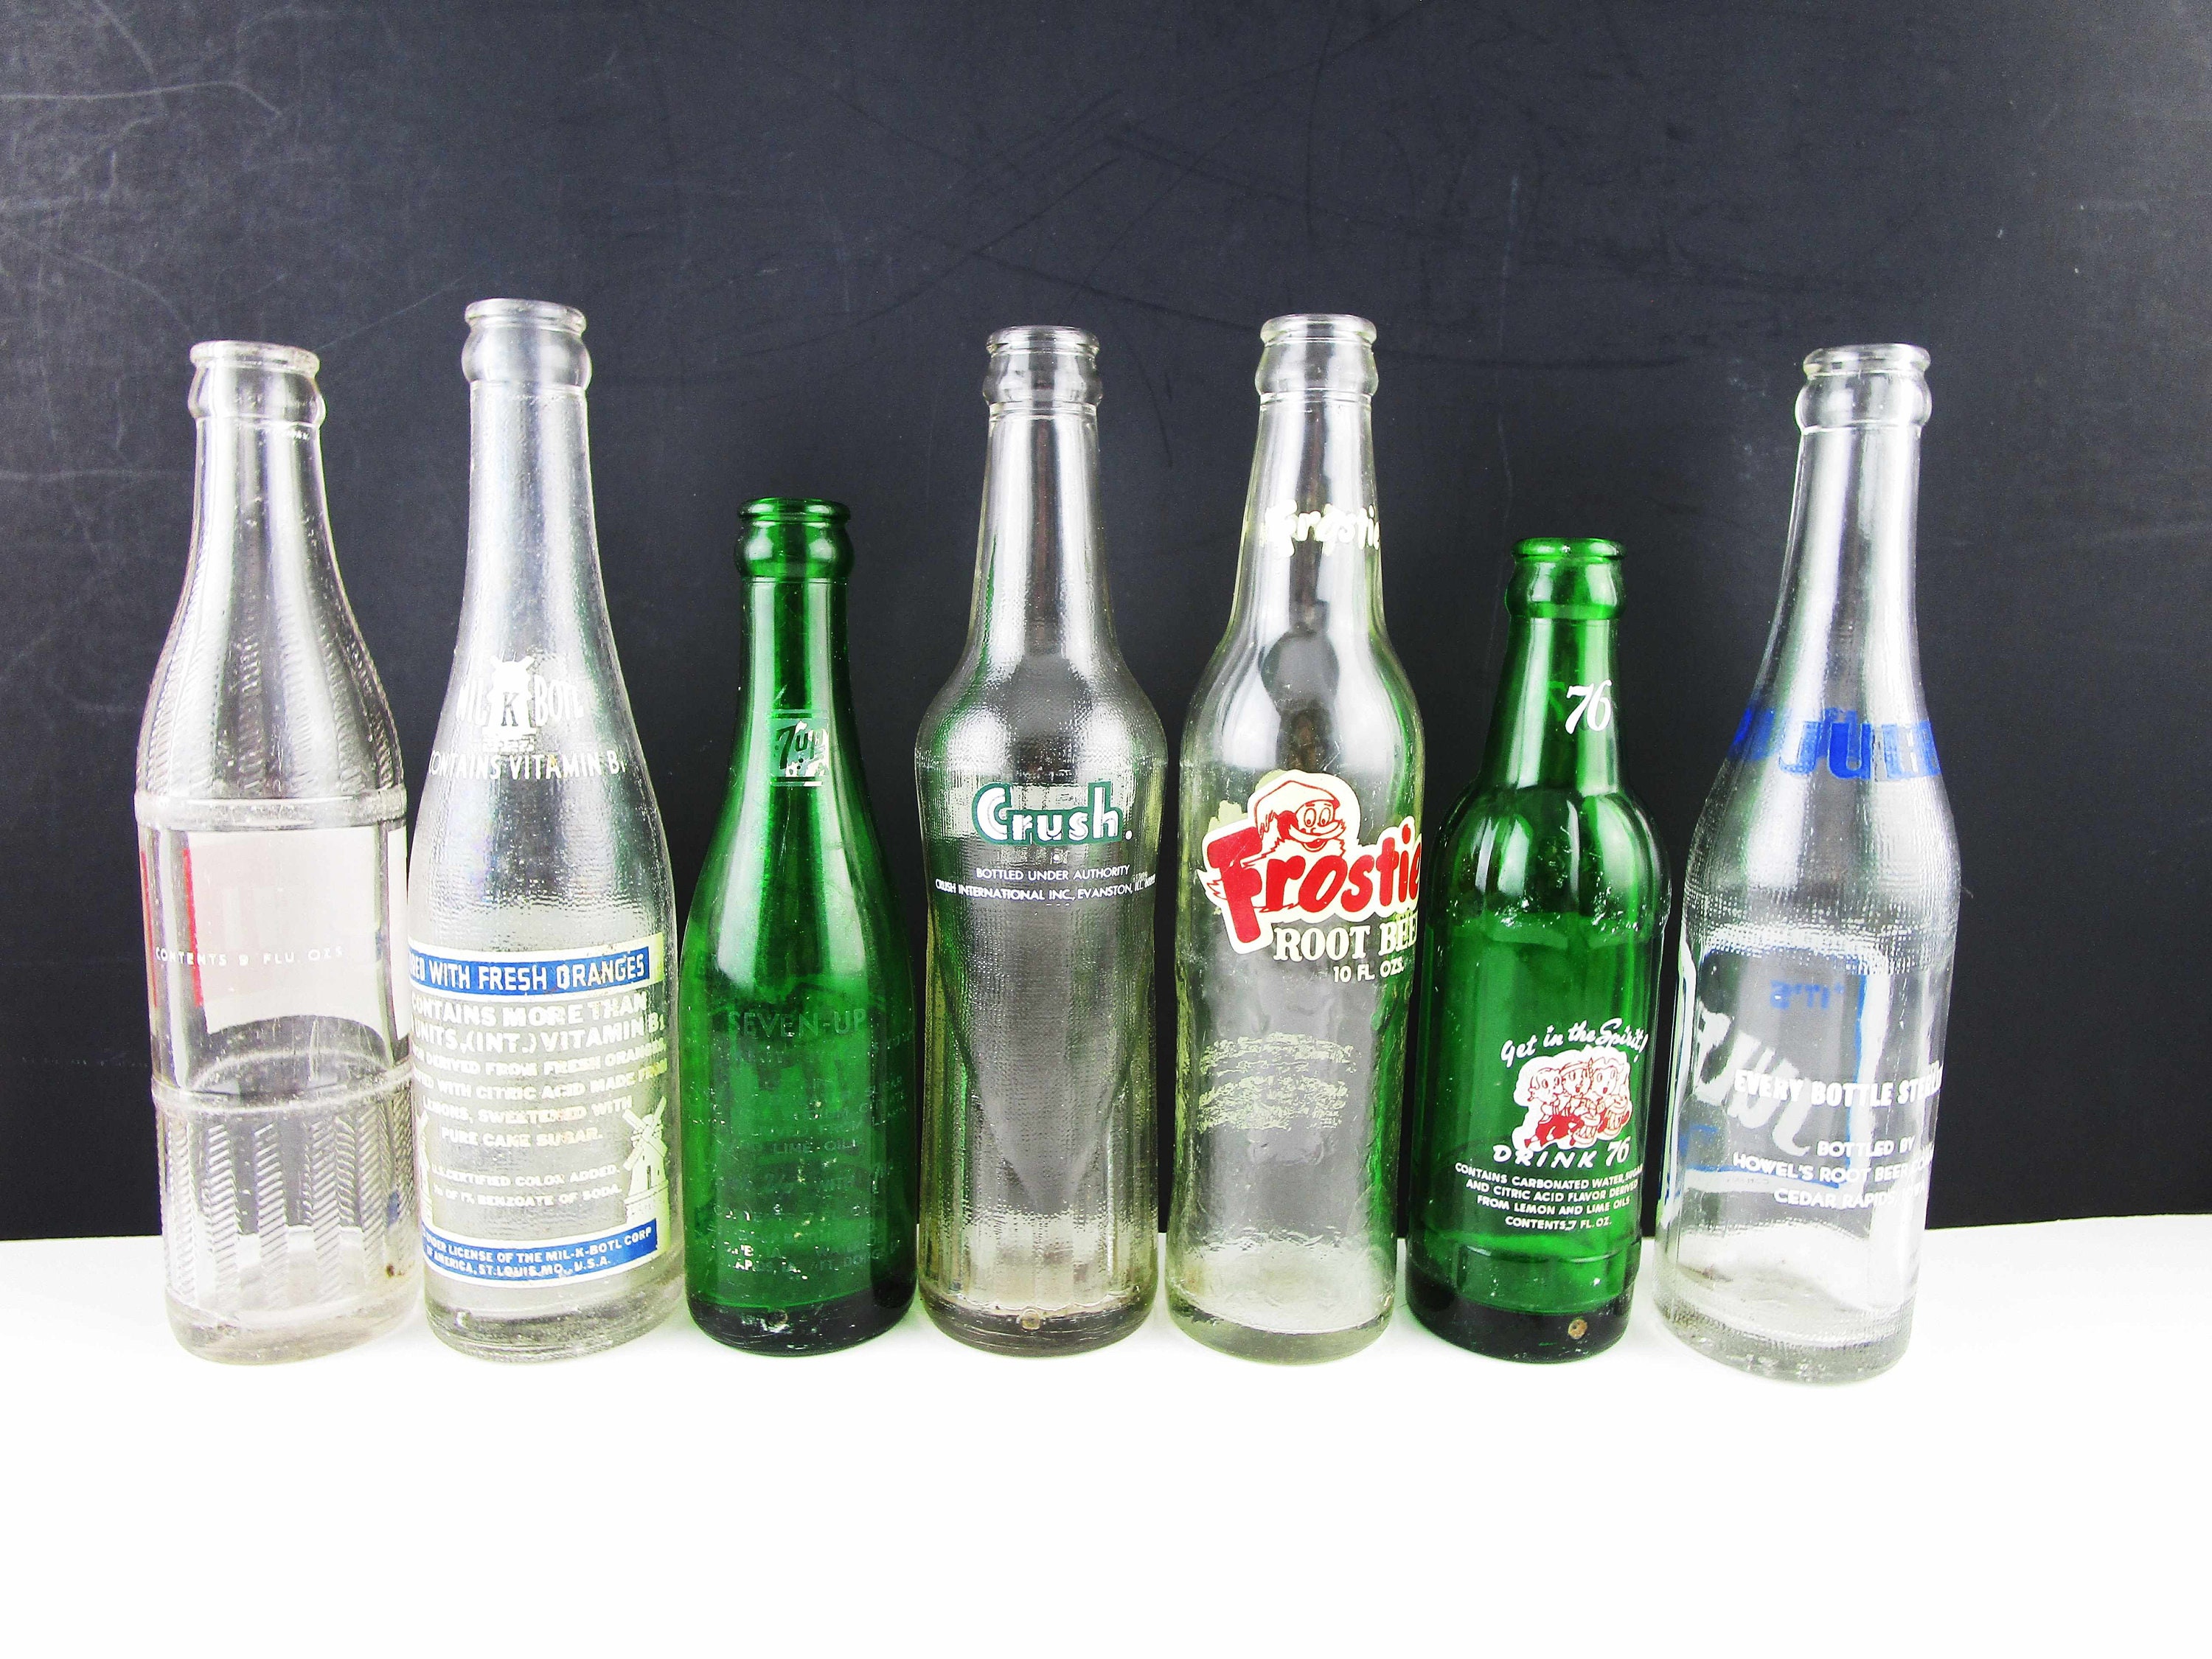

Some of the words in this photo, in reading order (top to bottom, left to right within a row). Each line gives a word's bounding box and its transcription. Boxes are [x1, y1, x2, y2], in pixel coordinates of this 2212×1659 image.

[501, 692, 519, 726] K
[1565, 679, 1613, 734] 76
[509, 751, 603, 779] VITAMIN
[976, 868, 1024, 880] BOTTLED
[1029, 870, 1069, 881] UNDER
[1073, 865, 1130, 880] AUTHORITY
[935, 879, 956, 894] CRUSH
[959, 884, 1045, 900] INTERNATIONAL
[1077, 883, 1133, 900] EVANSTON,
[156, 947, 227, 966] CONTENTS
[1273, 925, 1370, 961] ROOT
[428, 959, 470, 989] WITH
[479, 965, 547, 990] FRESH
[556, 953, 644, 990] ORANGES
[1333, 965, 1352, 983] 10
[412, 990, 496, 1026] CONTAINS
[503, 1004, 584, 1027] MORE
[588, 991, 648, 1020] THAN
[728, 1008, 866, 1037] SEVEN-UP
[540, 1018, 644, 1052] VITAMIN
[1500, 1034, 1537, 1068] Get
[1543, 1025, 1563, 1047] in
[1568, 1020, 1596, 1043] the
[1595, 1018, 1649, 1062] Spirit!
[437, 1079, 472, 1098] WITH
[476, 1085, 537, 1100] CITRIC
[541, 1082, 586, 1099] ACID
[590, 1071, 636, 1093] MADE
[1734, 1069, 1804, 1105] EVERY
[1811, 1081, 1893, 1107] BOTTLE
[591, 1095, 633, 1116] WITH
[442, 1127, 478, 1147] PURE
[482, 1134, 532, 1148] CANE
[1817, 1140, 1894, 1158] BOTTLED
[1899, 1135, 1915, 1153] BY
[1492, 1144, 1597, 1169] DRINK
[1605, 1135, 1632, 1166] 76
[515, 1174, 565, 1186] COLOR
[1455, 1162, 1507, 1183] CONTAINS
[1512, 1176, 1589, 1189] CARBONATED
[1733, 1152, 1815, 1180] HOWEL'S
[1819, 1166, 1871, 1183] ROOT
[1874, 1163, 1908, 1182] BEER
[477, 1194, 554, 1207] BENZOATE
[558, 1192, 579, 1205] OF
[1466, 1179, 1489, 1192] AND
[1493, 1186, 1531, 1200] CITRIC
[1534, 1192, 1564, 1202] ACID
[1568, 1190, 1606, 1203] FLAVOR
[1609, 1179, 1638, 1198] DERIVED
[1477, 1195, 1509, 1210] FROM
[1514, 1203, 1555, 1215] LEMON
[1559, 1206, 1583, 1215] AND
[1586, 1202, 1610, 1214] LIME
[1613, 1196, 1630, 1209] OILS
[1774, 1188, 1837, 1209] CEDAR
[448, 1244, 493, 1262] LICENSE
[496, 1252, 514, 1264] OF
[517, 1251, 543, 1264] THE
[546, 1239, 622, 1260] MIL-K-BOTL
[624, 1226, 652, 1246] CORP
